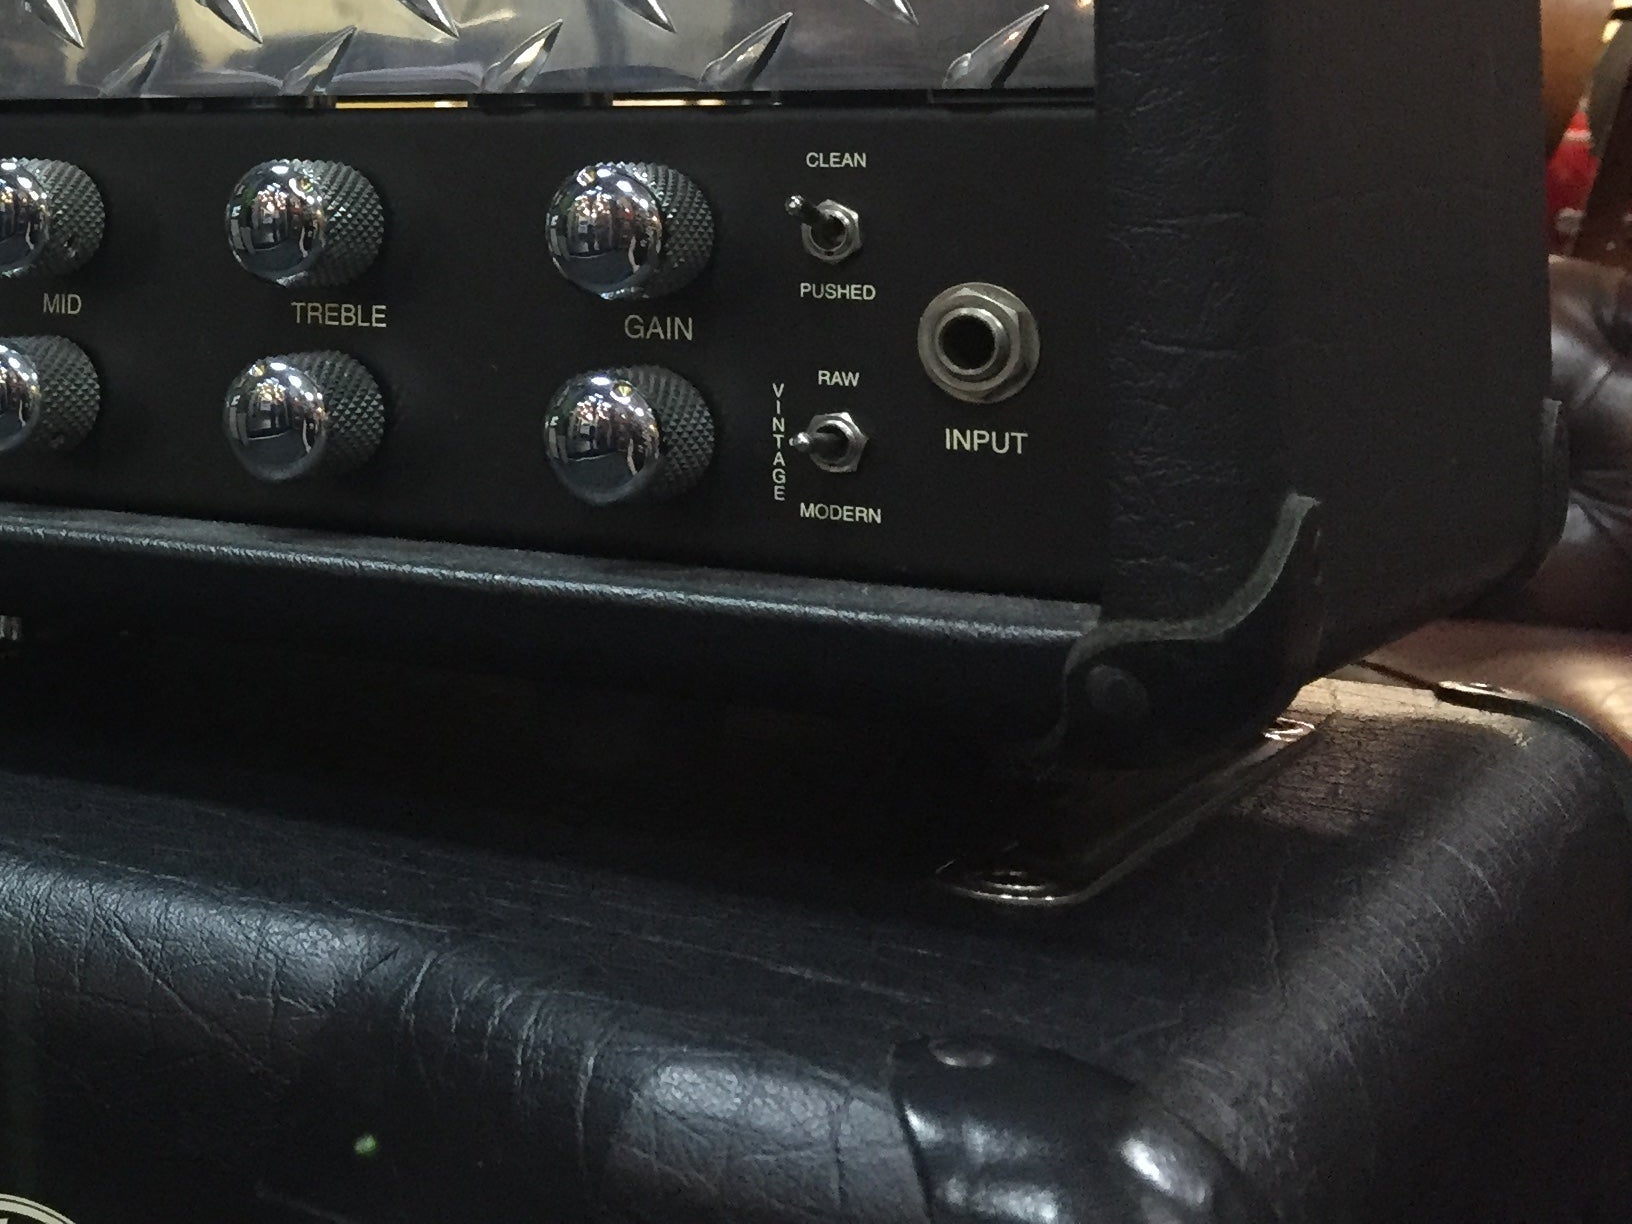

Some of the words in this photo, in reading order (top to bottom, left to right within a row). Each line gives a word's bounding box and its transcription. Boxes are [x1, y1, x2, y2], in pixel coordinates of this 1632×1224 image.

[806, 152, 866, 167] CLEAN
[800, 282, 876, 301] PUSHED
[43, 293, 82, 315] MID
[291, 302, 387, 328] TREBLE
[624, 315, 693, 341] GAIN
[818, 370, 860, 387] RAW
[772, 383, 786, 501] VINTAGE
[945, 428, 1029, 455] INPUT
[800, 503, 882, 524] MODERN
